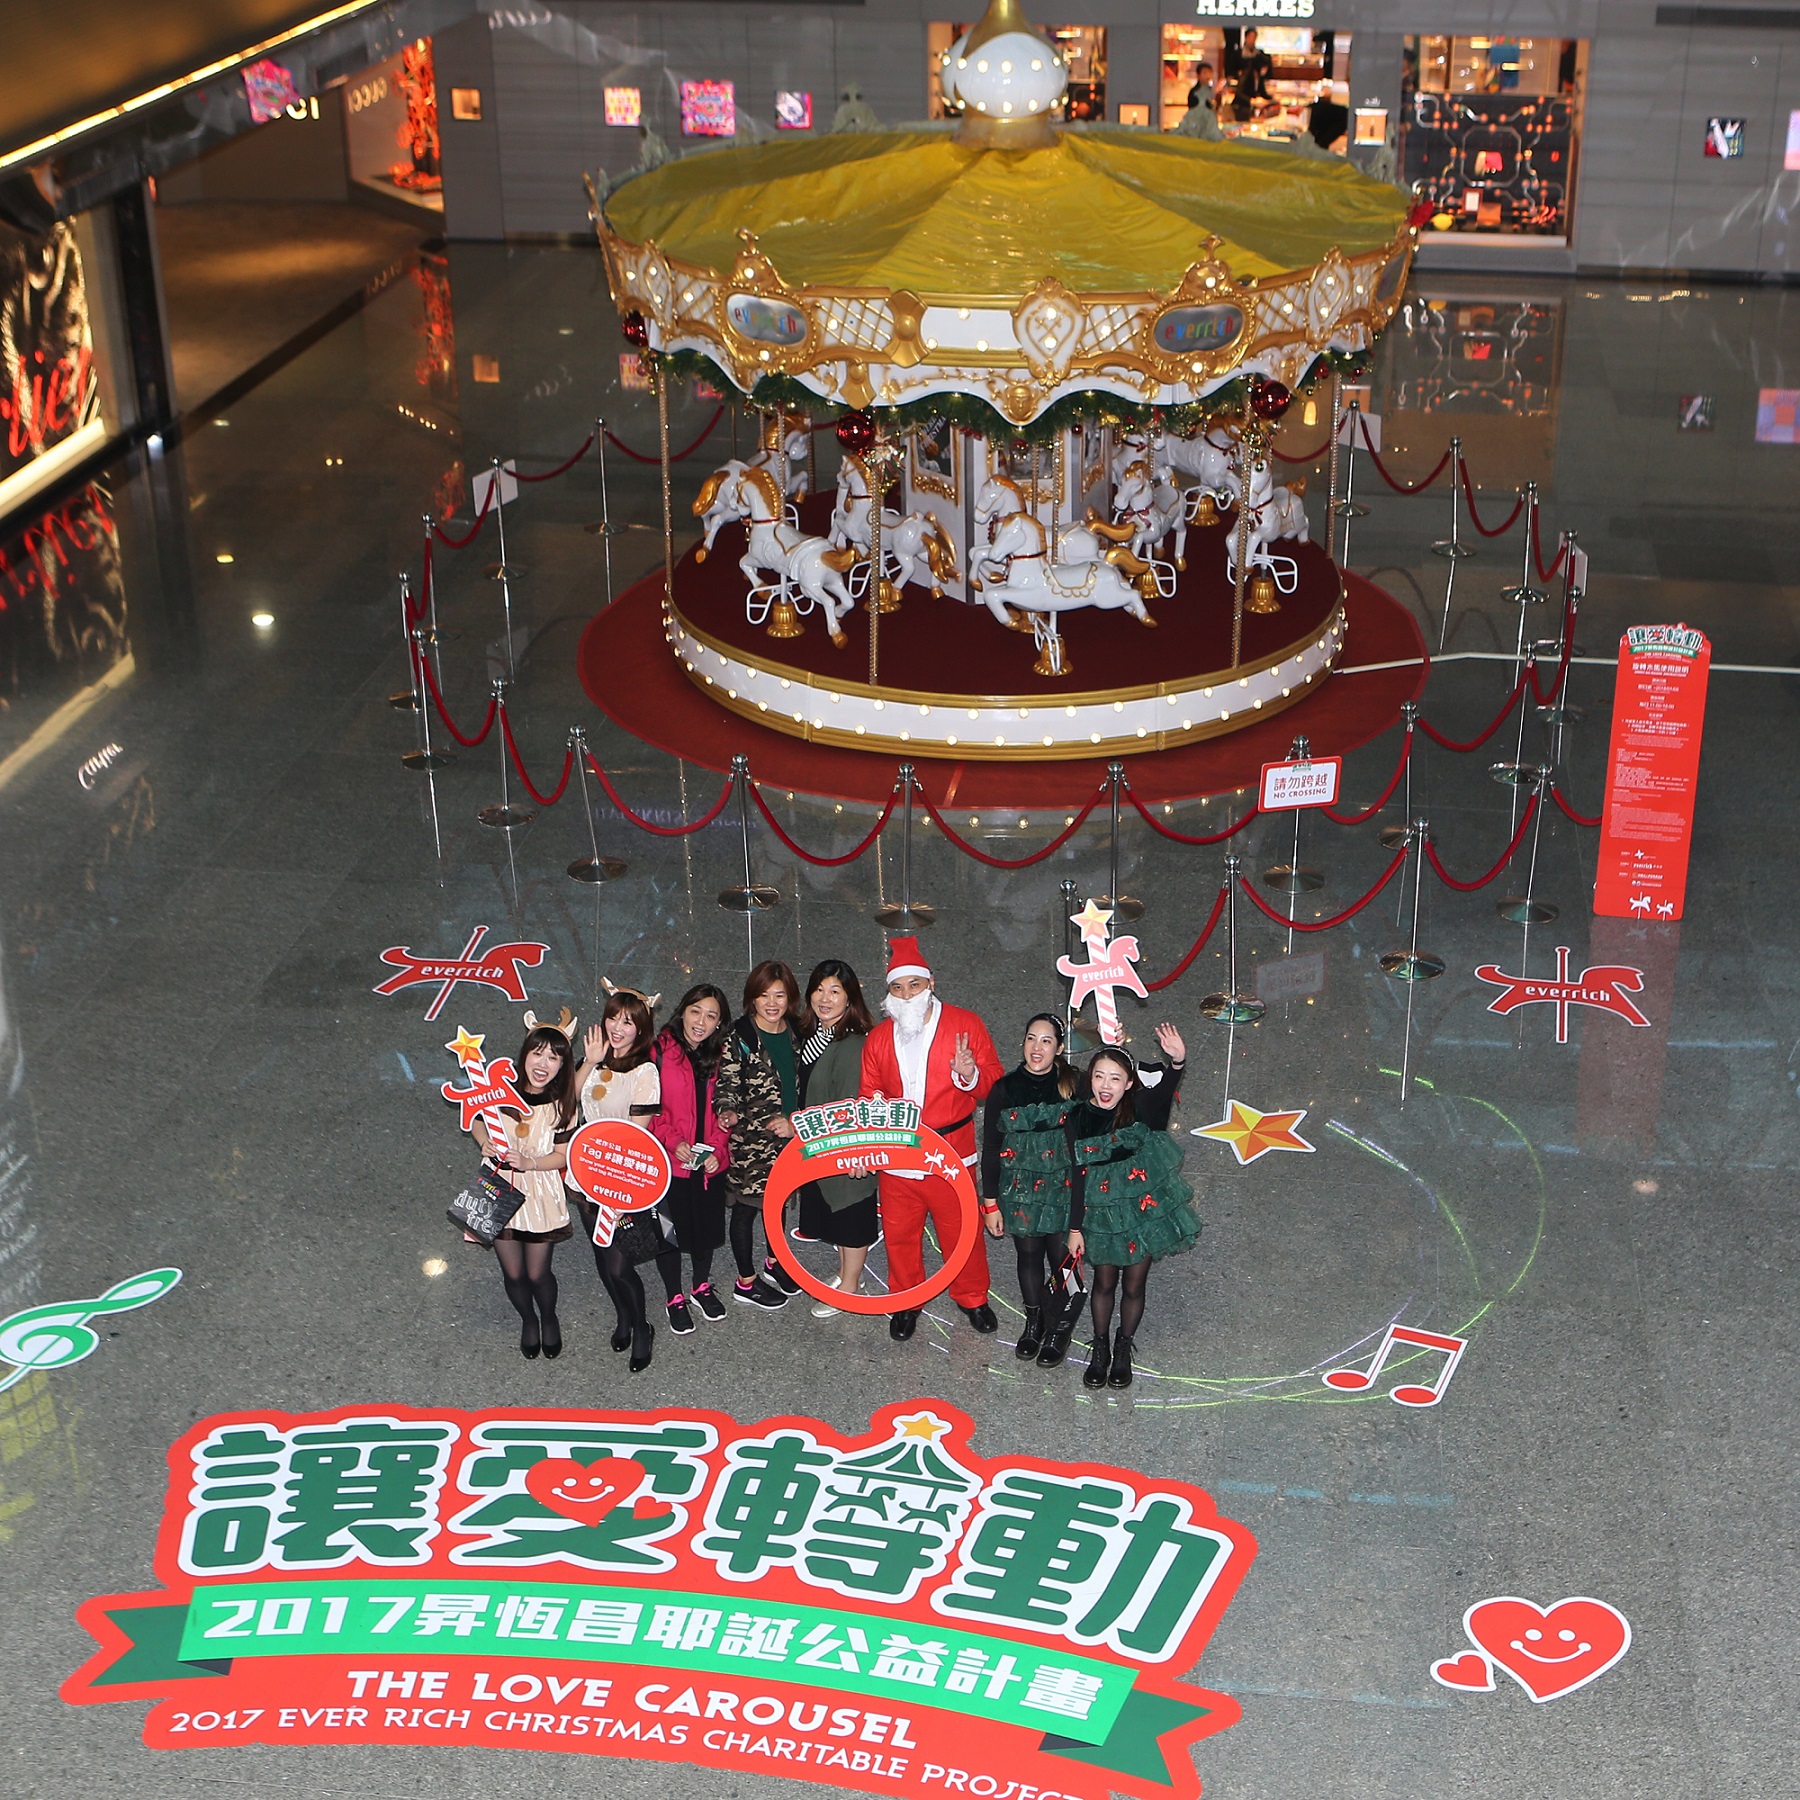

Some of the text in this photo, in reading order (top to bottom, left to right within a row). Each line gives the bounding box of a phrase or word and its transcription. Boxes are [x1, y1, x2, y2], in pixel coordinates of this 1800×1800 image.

[1274, 773, 1328, 791] 請勿跨越
[1288, 788, 1327, 798] CROSSING
[420, 965, 504, 979] everrich
[1081, 965, 1125, 983] everrich
[1525, 986, 1610, 1002] everrich
[466, 1086, 507, 1107] everrich
[793, 1100, 920, 1142] 讓愛轉動
[582, 1143, 603, 1160] Tag
[836, 1151, 890, 1170] everrich
[454, 1190, 498, 1218] duty
[593, 1184, 633, 1204] everrich
[467, 1210, 503, 1237] free
[184, 1418, 1228, 1658] 讓愛轉動
[203, 1593, 1103, 1721] 2017昇恆昌耶誕公益計畫
[346, 1670, 917, 1749] THE LOVE CAROUSEL
[169, 1707, 1084, 1800] 2017 EVER RICH CHRISTMAS CHARITABLE PROJE
